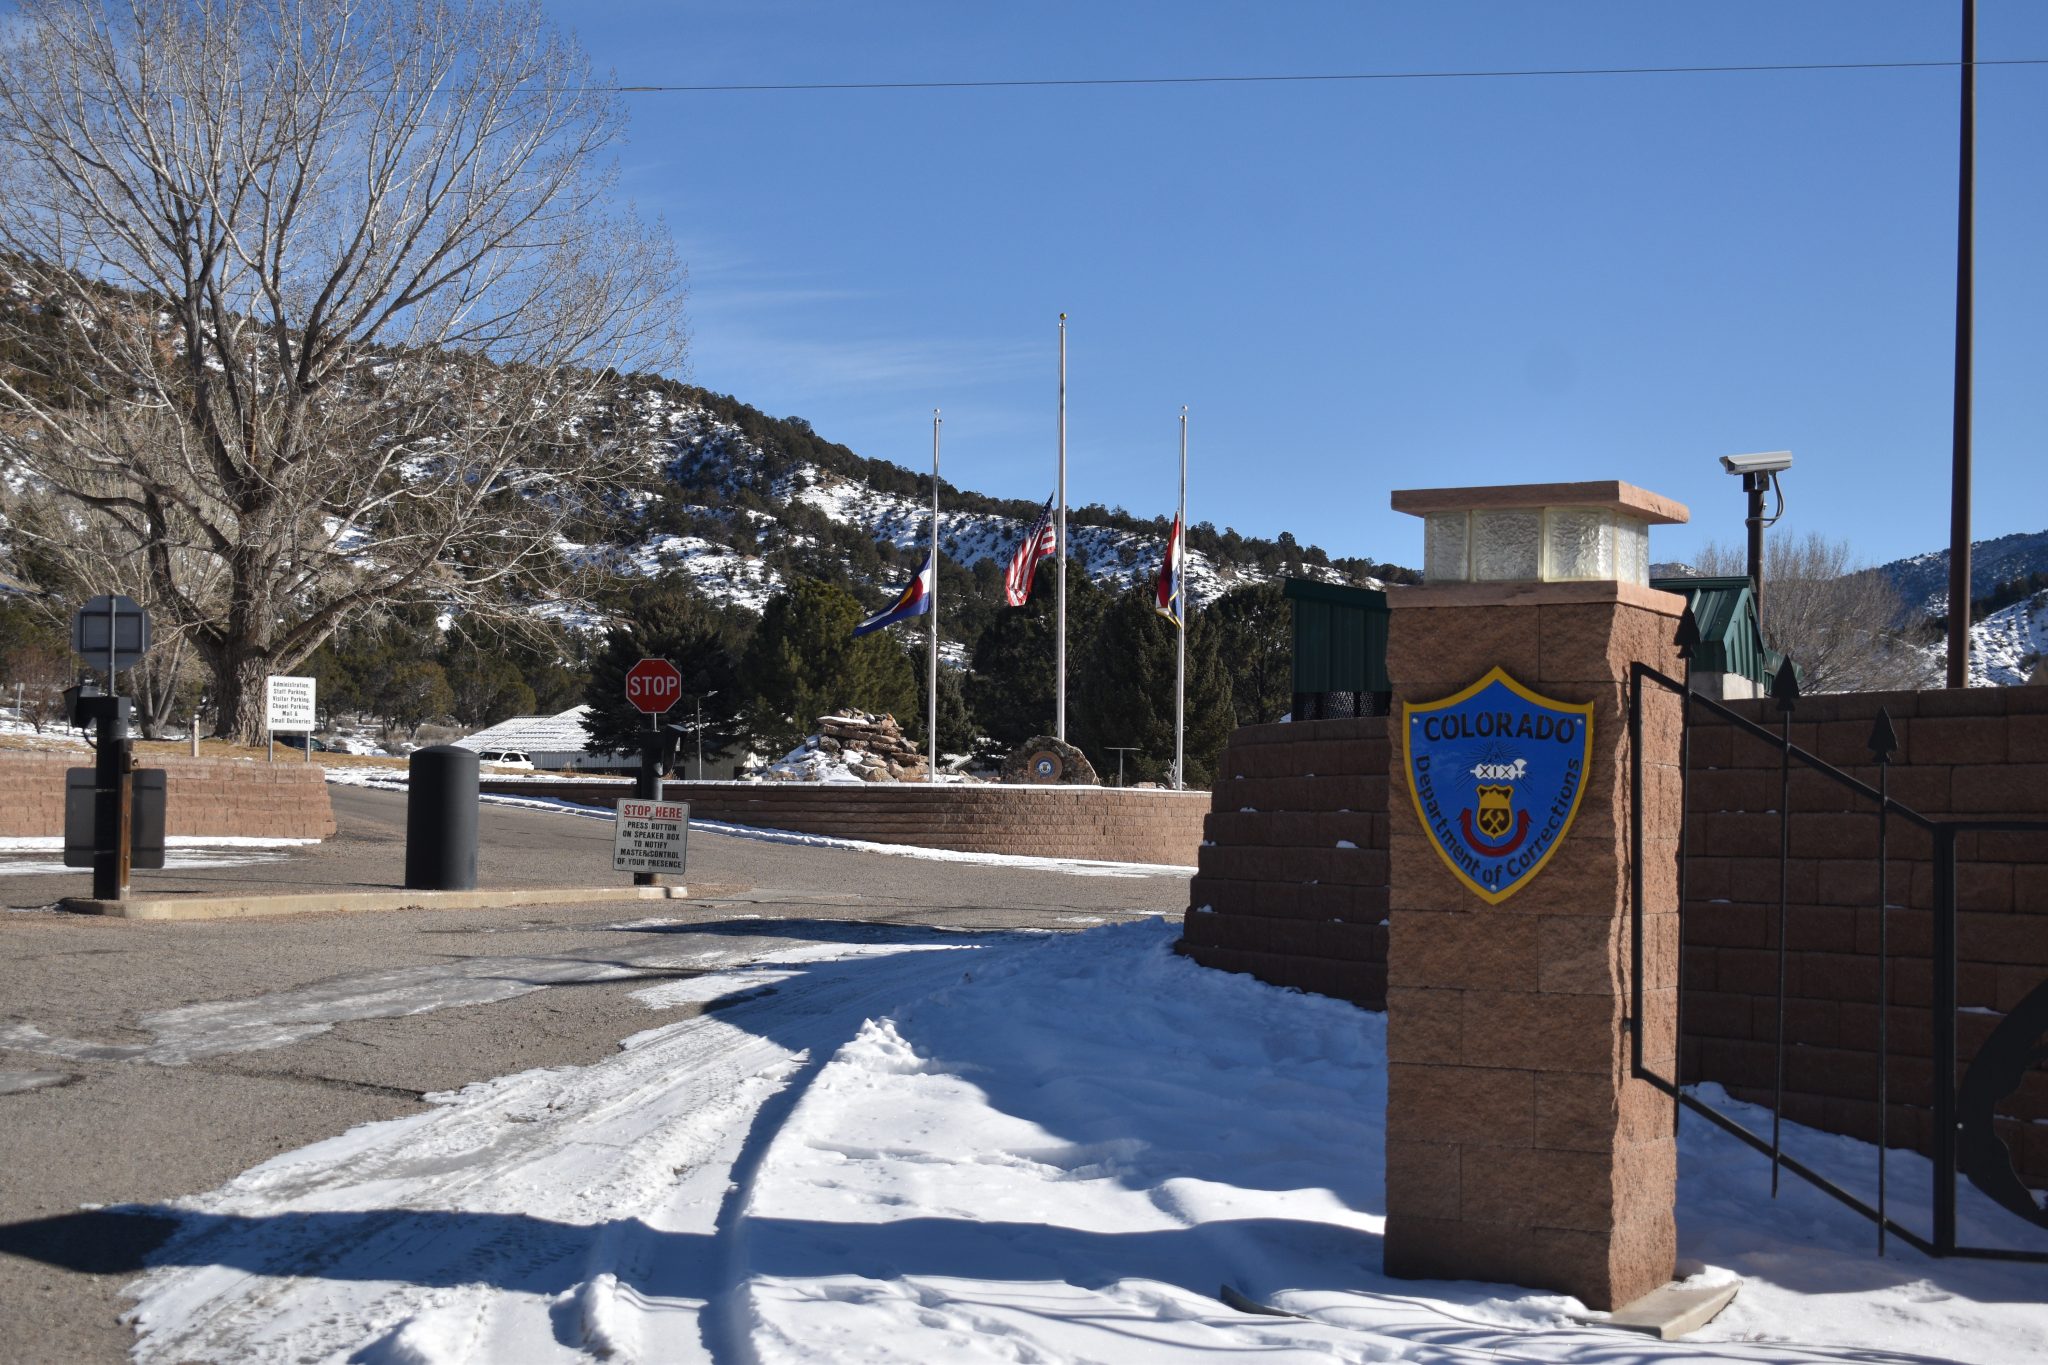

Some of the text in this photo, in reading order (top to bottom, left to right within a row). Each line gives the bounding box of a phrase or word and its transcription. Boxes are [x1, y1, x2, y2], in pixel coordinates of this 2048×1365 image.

[630, 676, 678, 696] STOP
[1424, 711, 1575, 744] COLORADO
[1479, 765, 1512, 779] XIX
[624, 804, 682, 818] STOP HERE
[1415, 754, 1580, 883] Department of Corrections
[627, 821, 677, 831] PRESS BUTTON
[622, 830, 631, 838] ON
[634, 831, 664, 839] SPEAKER
[644, 841, 668, 849] NOTIFY
[620, 848, 679, 859] MASTER CONTROL
[647, 860, 682, 868] PRESENCE
